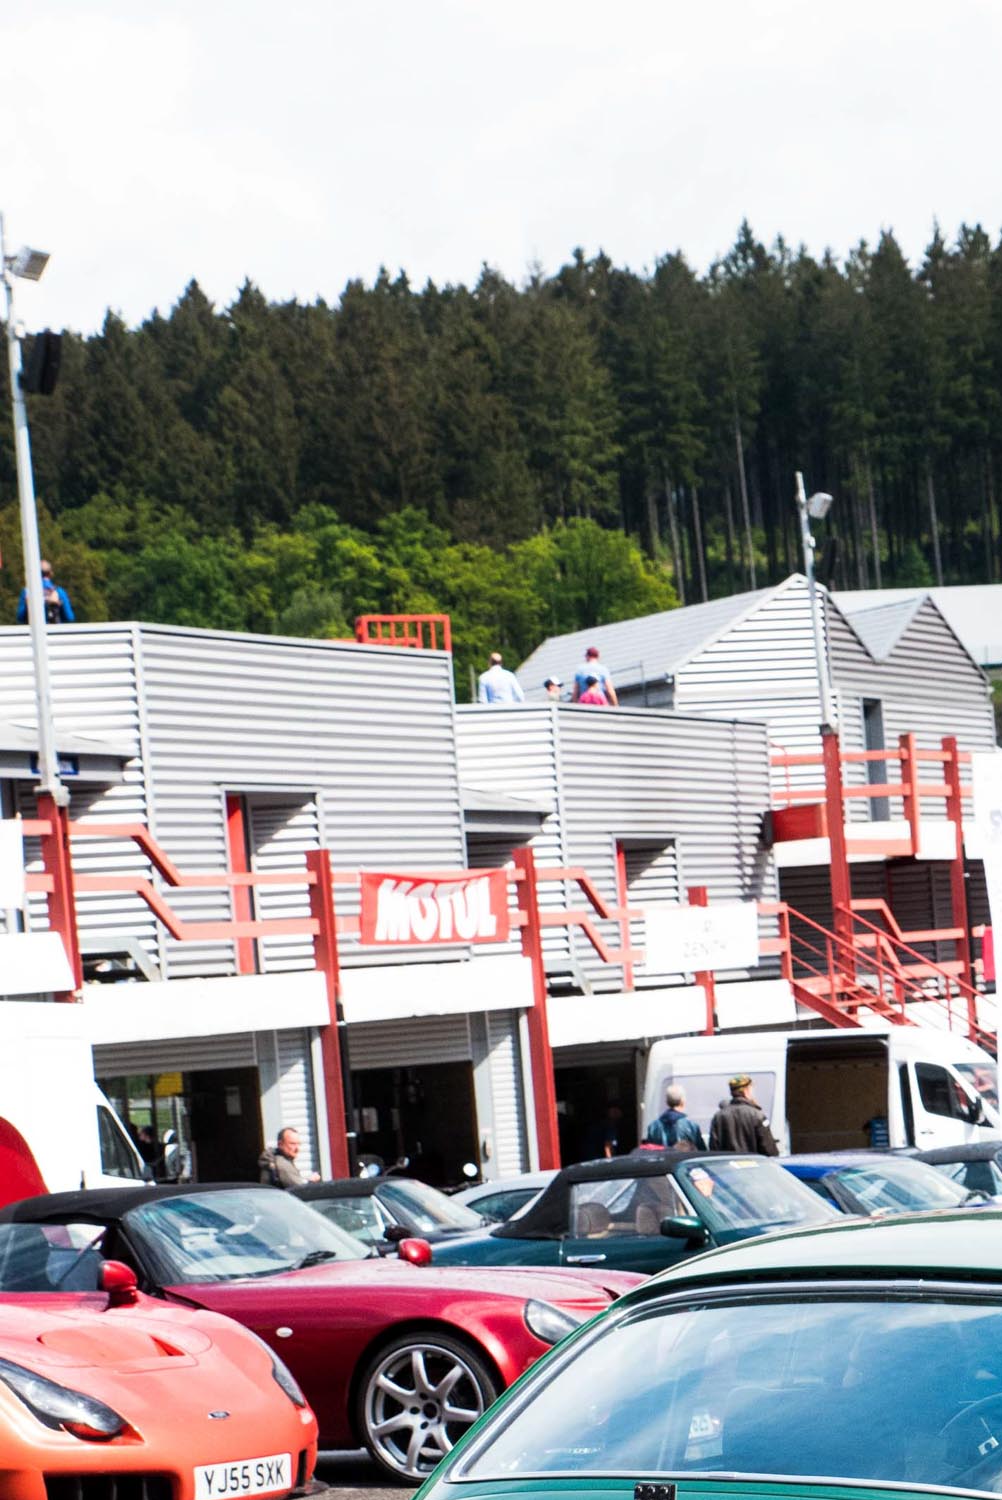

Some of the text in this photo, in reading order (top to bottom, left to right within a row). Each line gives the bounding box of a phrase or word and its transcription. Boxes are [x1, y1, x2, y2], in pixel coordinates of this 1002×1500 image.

[375, 876, 497, 941] MOTUL
[205, 1459, 284, 1494] YJ55 SXK
